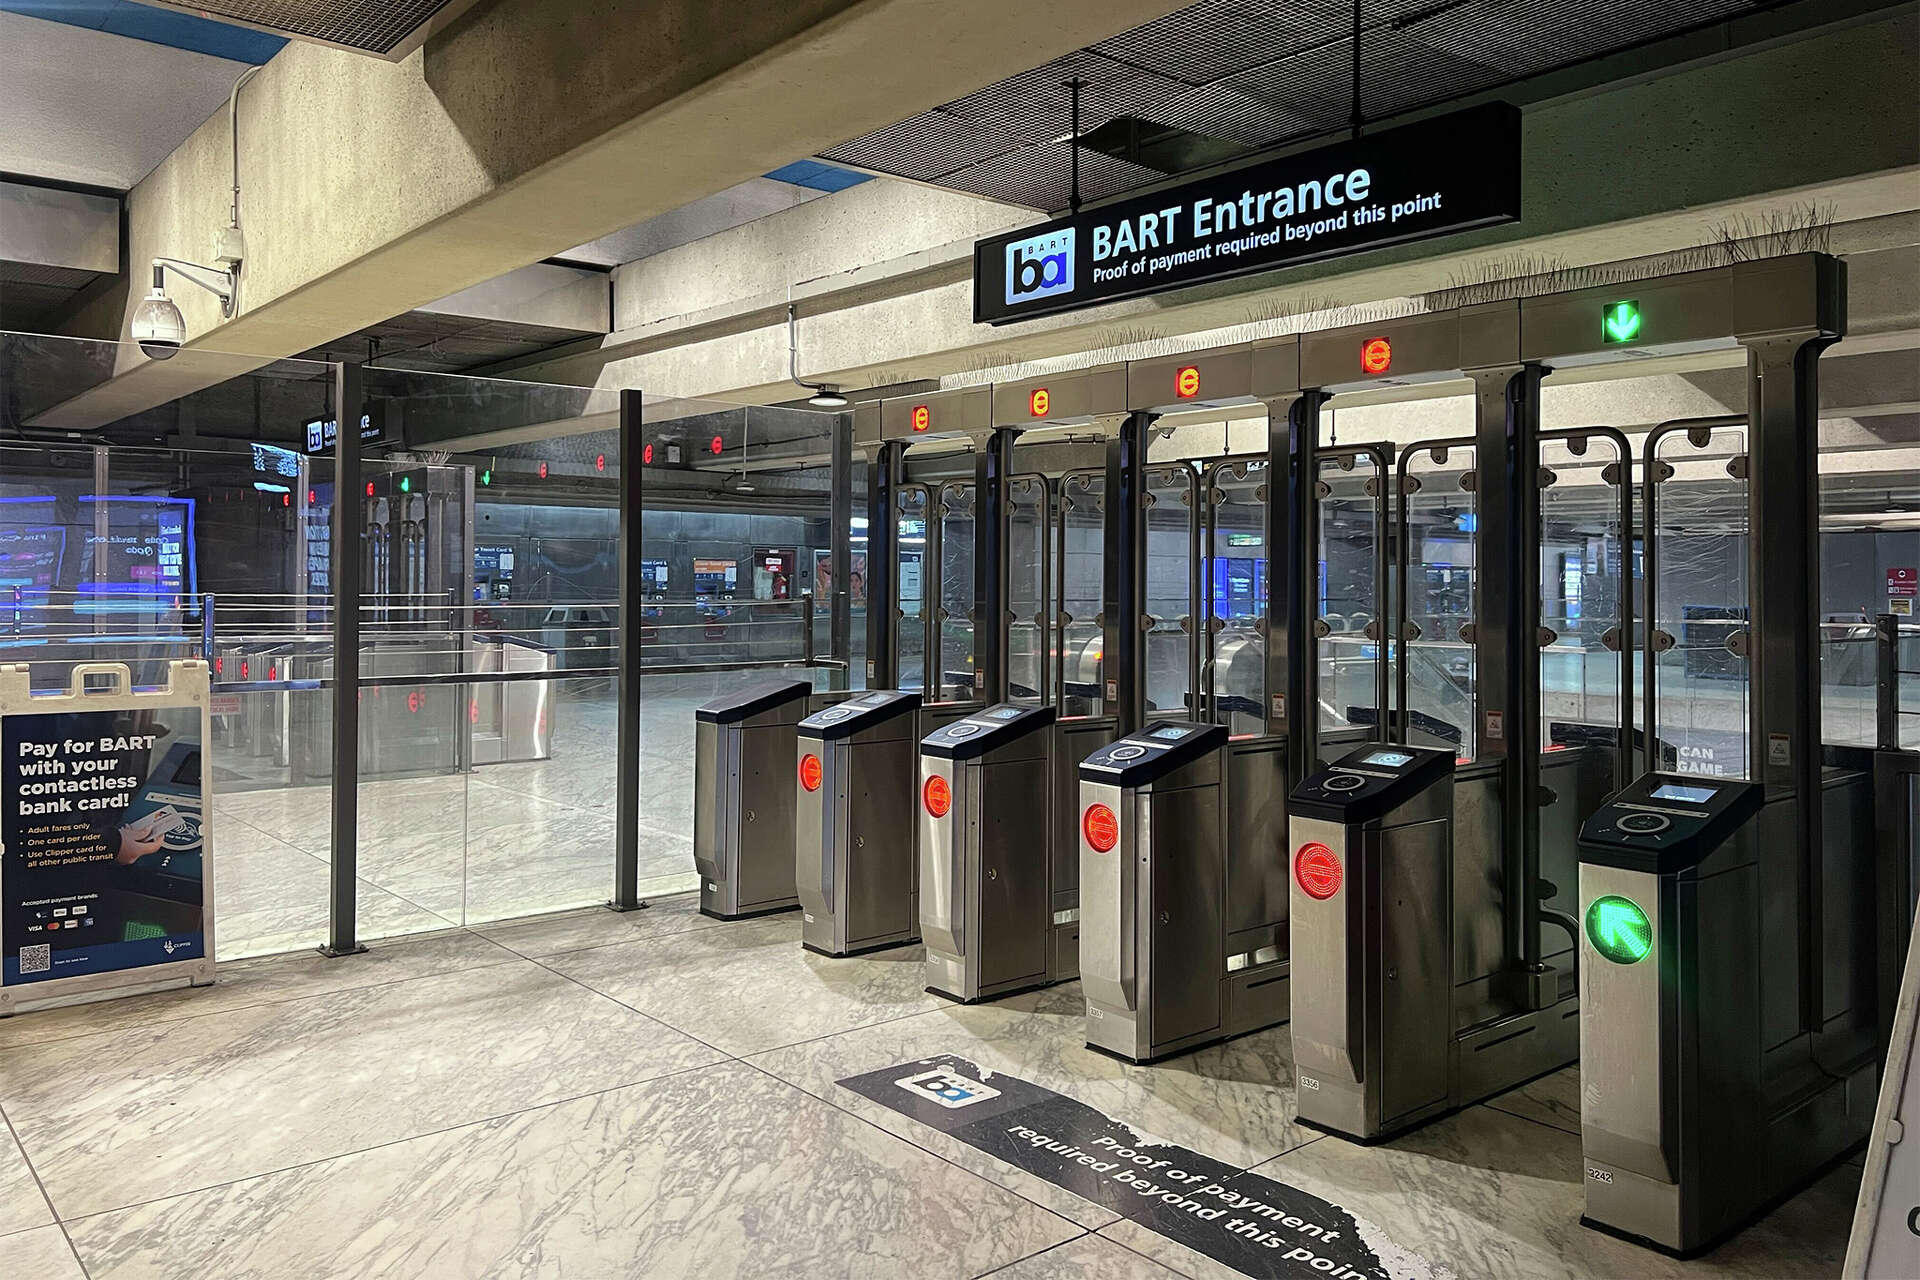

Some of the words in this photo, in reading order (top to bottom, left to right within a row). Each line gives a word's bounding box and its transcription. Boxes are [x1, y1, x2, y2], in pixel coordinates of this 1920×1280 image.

[1093, 206, 1182, 262] BART
[1194, 168, 1371, 239] Entrance
[1028, 237, 1068, 255] BART
[1093, 261, 1129, 283] Proof
[1131, 256, 1146, 275] of
[1149, 243, 1212, 275] payment
[1215, 225, 1280, 256] required
[1285, 210, 1348, 241] beyond
[1352, 203, 1386, 226] this
[1391, 191, 1442, 223] point
[323, 419, 338, 438] BAR
[19, 742, 58, 758] Pay
[64, 740, 94, 754] for
[99, 735, 156, 752] BART
[1679, 745, 1714, 760] CAN
[19, 759, 66, 776] with
[71, 758, 119, 775] your
[19, 775, 138, 796] contactless
[19, 797, 72, 816] bank
[77, 793, 130, 811] card!
[27, 825, 50, 834] Adult
[51, 823, 72, 832] fares
[73, 822, 91, 831] only
[27, 838, 45, 846] One
[47, 836, 65, 844] card
[66, 835, 81, 845] per
[82, 832, 101, 841] rider
[27, 850, 44, 858] Use
[45, 847, 74, 857] Clipper
[75, 844, 94, 854] card
[95, 843, 108, 852] for
[27, 860, 38, 868] all
[39, 858, 61, 867] other
[62, 855, 88, 866] public
[88, 852, 114, 861] transit
[27, 924, 43, 932] VISA
[1588, 1168, 1612, 1183] 2242
[1007, 1125, 1120, 1173] required
[1112, 1169, 1229, 1221] beyond
[1224, 1217, 1286, 1249] this
[1090, 1136, 1173, 1169] Proof
[1166, 1168, 1209, 1184] of
[1197, 1182, 1342, 1243] payment
